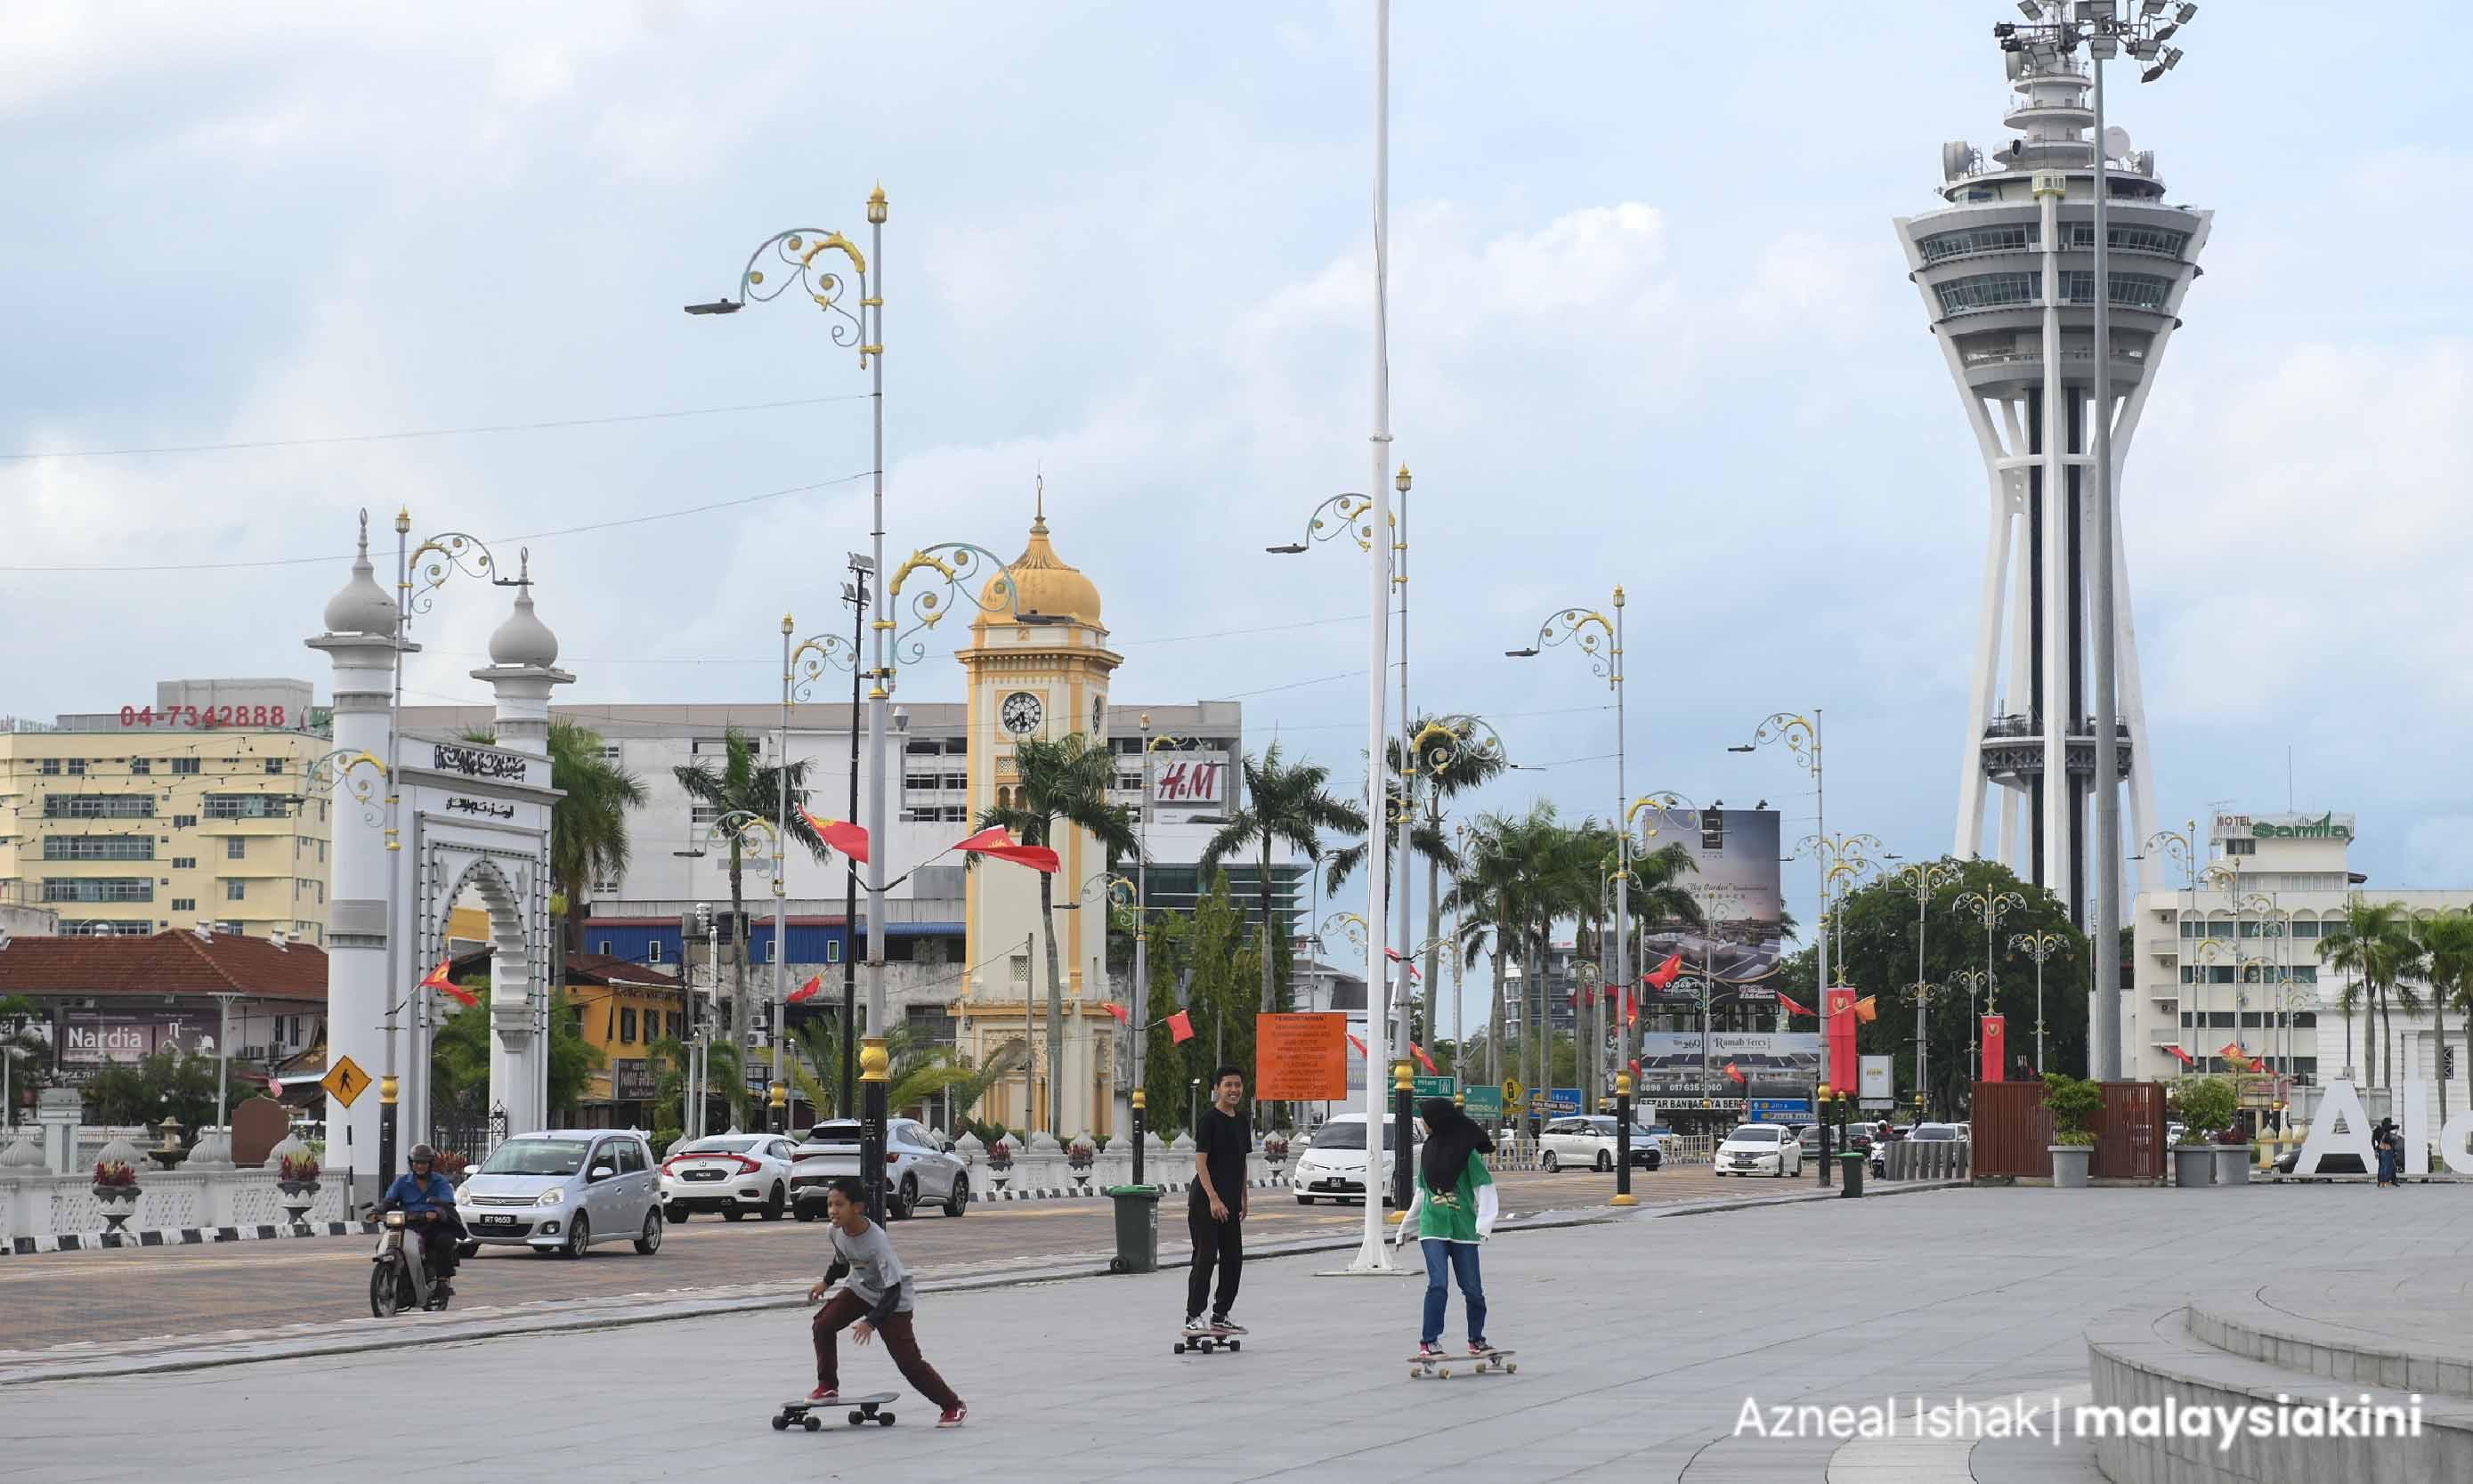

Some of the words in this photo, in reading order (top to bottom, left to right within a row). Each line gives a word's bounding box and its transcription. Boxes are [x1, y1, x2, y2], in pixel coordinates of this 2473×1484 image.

[120, 705, 286, 727] 04-7342888
[1158, 762, 1217, 800] H&M
[2217, 815, 2251, 827] HOTEL
[68, 1026, 142, 1048] Nardia
[1670, 1099, 1722, 1109] BANDARYA
